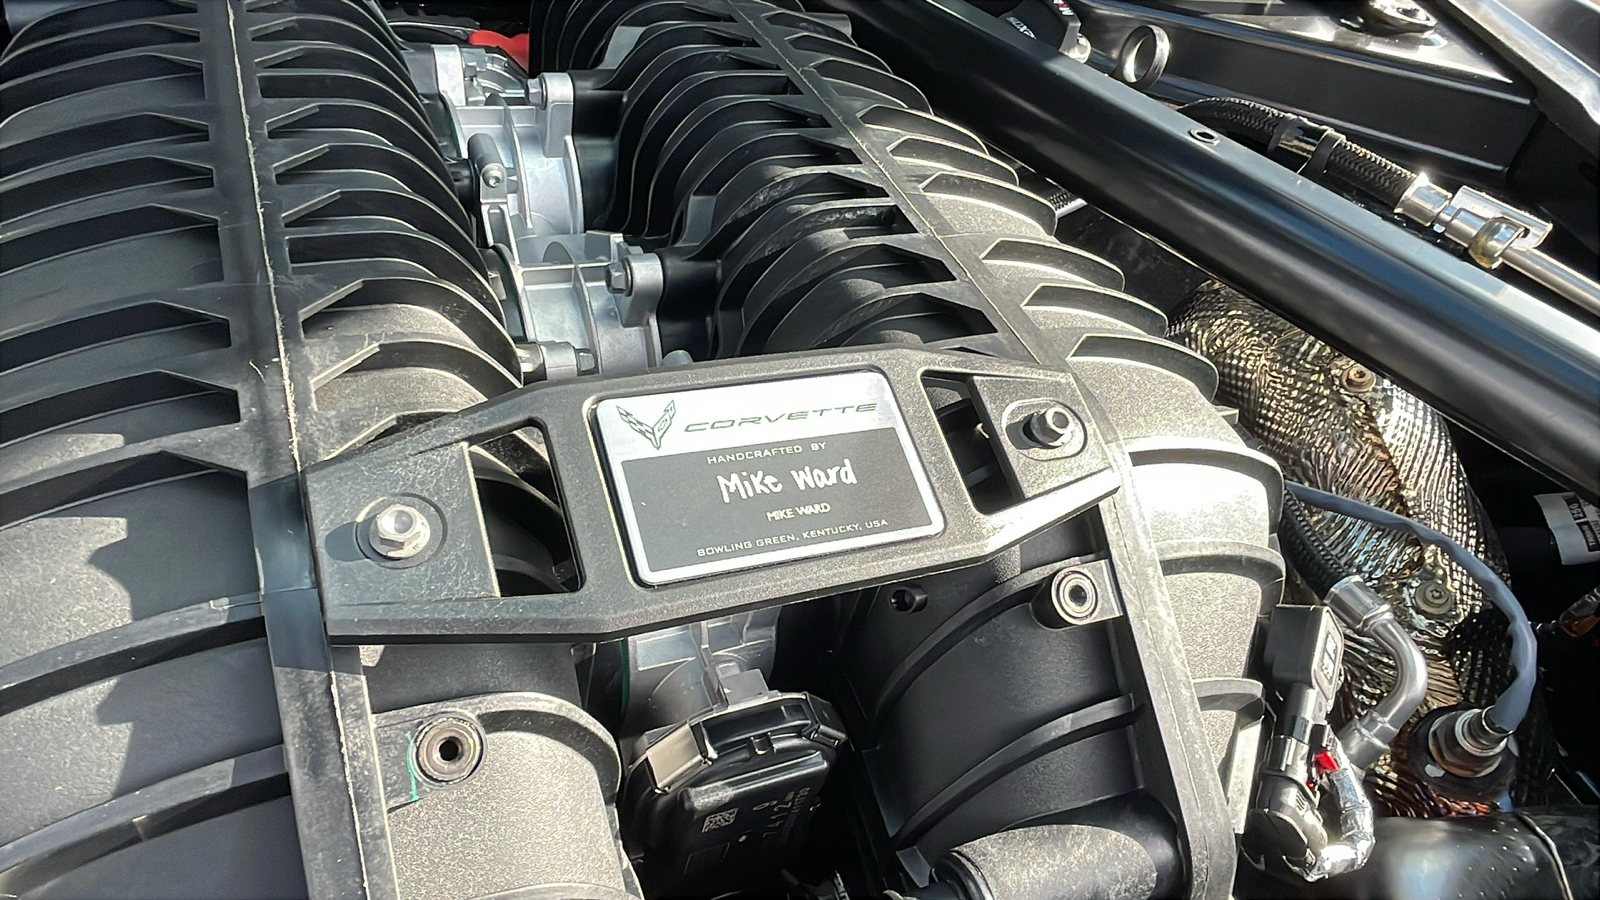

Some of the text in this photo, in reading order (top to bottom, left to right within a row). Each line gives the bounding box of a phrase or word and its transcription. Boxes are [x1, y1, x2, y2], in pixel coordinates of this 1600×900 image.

[684, 403, 878, 433] CORVETTE
[706, 442, 827, 464] HANDCRAFTED BY
[790, 458, 858, 490] Ward
[766, 502, 831, 522] MIKE WARD
[697, 518, 889, 557] BOWLING GREEN, KENTUCKY, USA
